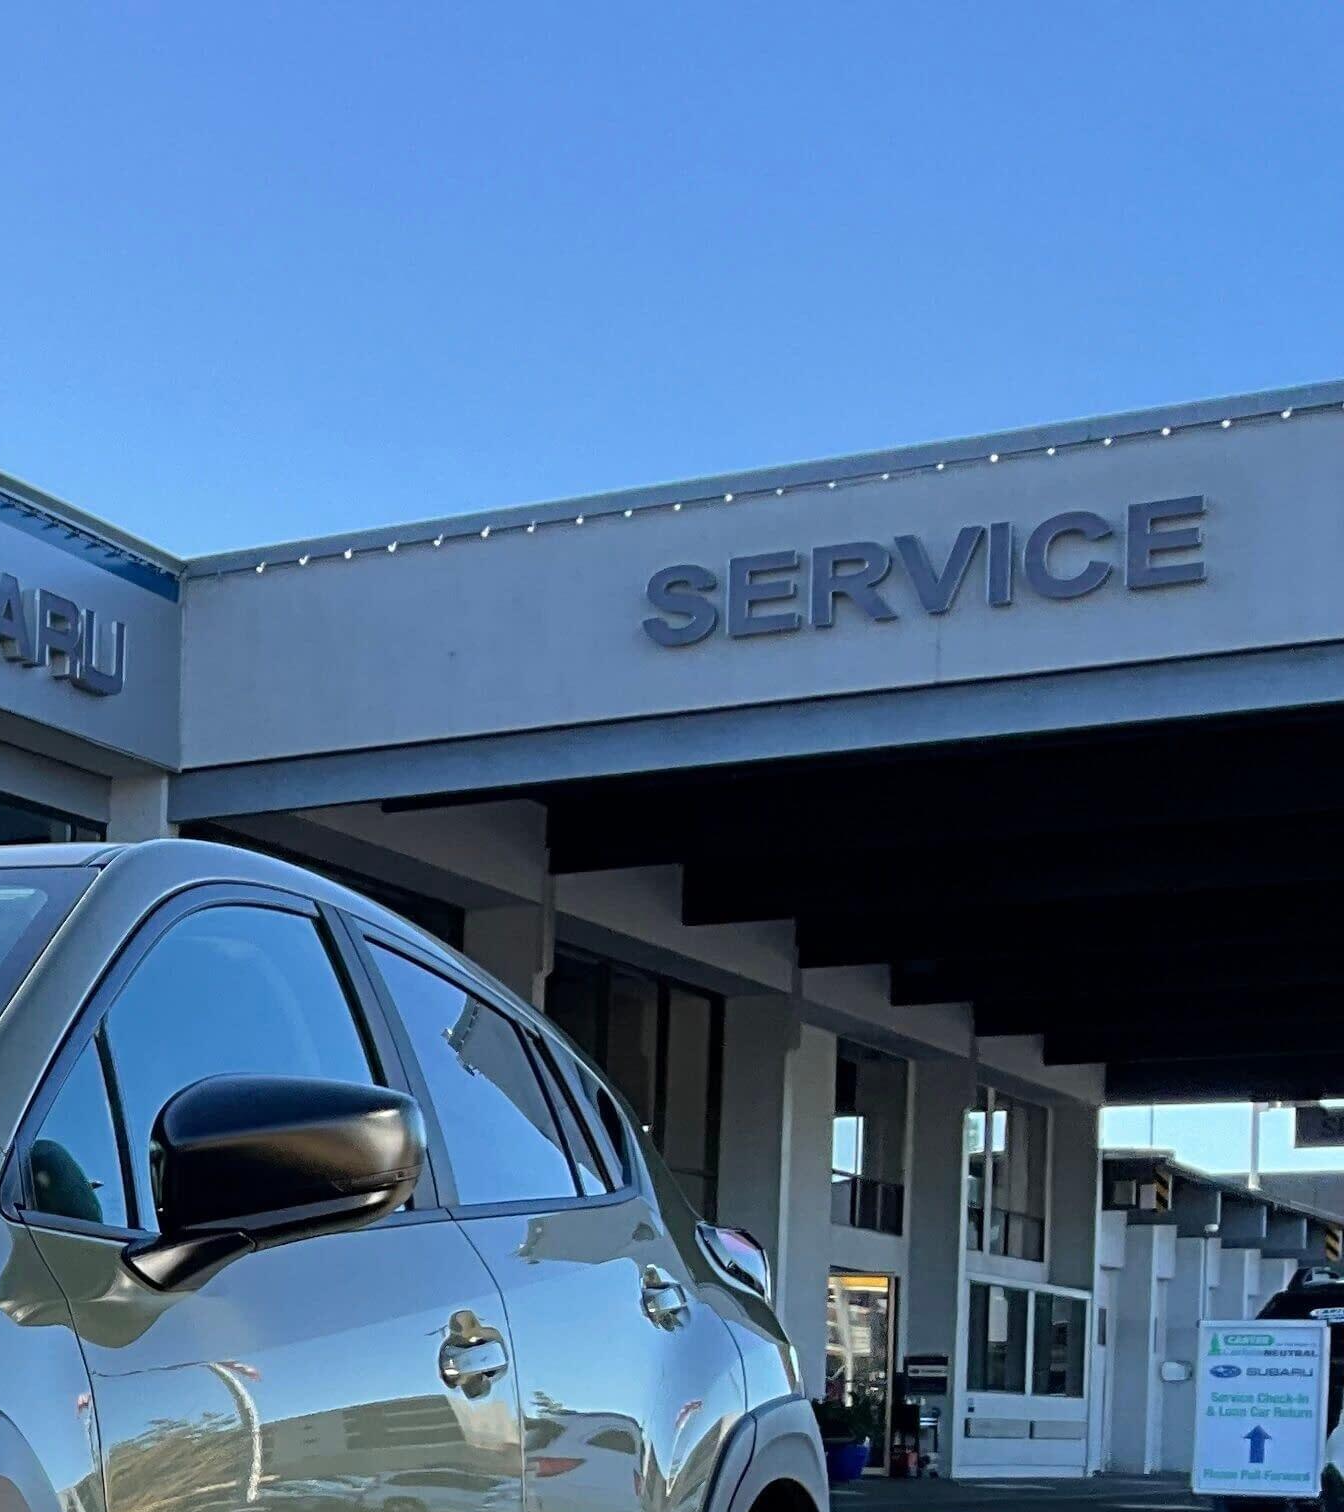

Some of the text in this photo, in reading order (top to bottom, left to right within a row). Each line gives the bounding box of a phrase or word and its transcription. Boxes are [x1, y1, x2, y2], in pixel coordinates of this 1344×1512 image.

[642, 495, 1208, 648] SERVICE
[1246, 1367, 1313, 1377] SUBARU
[1210, 1392, 1254, 1403] Service
[1250, 1406, 1271, 1417] Car
